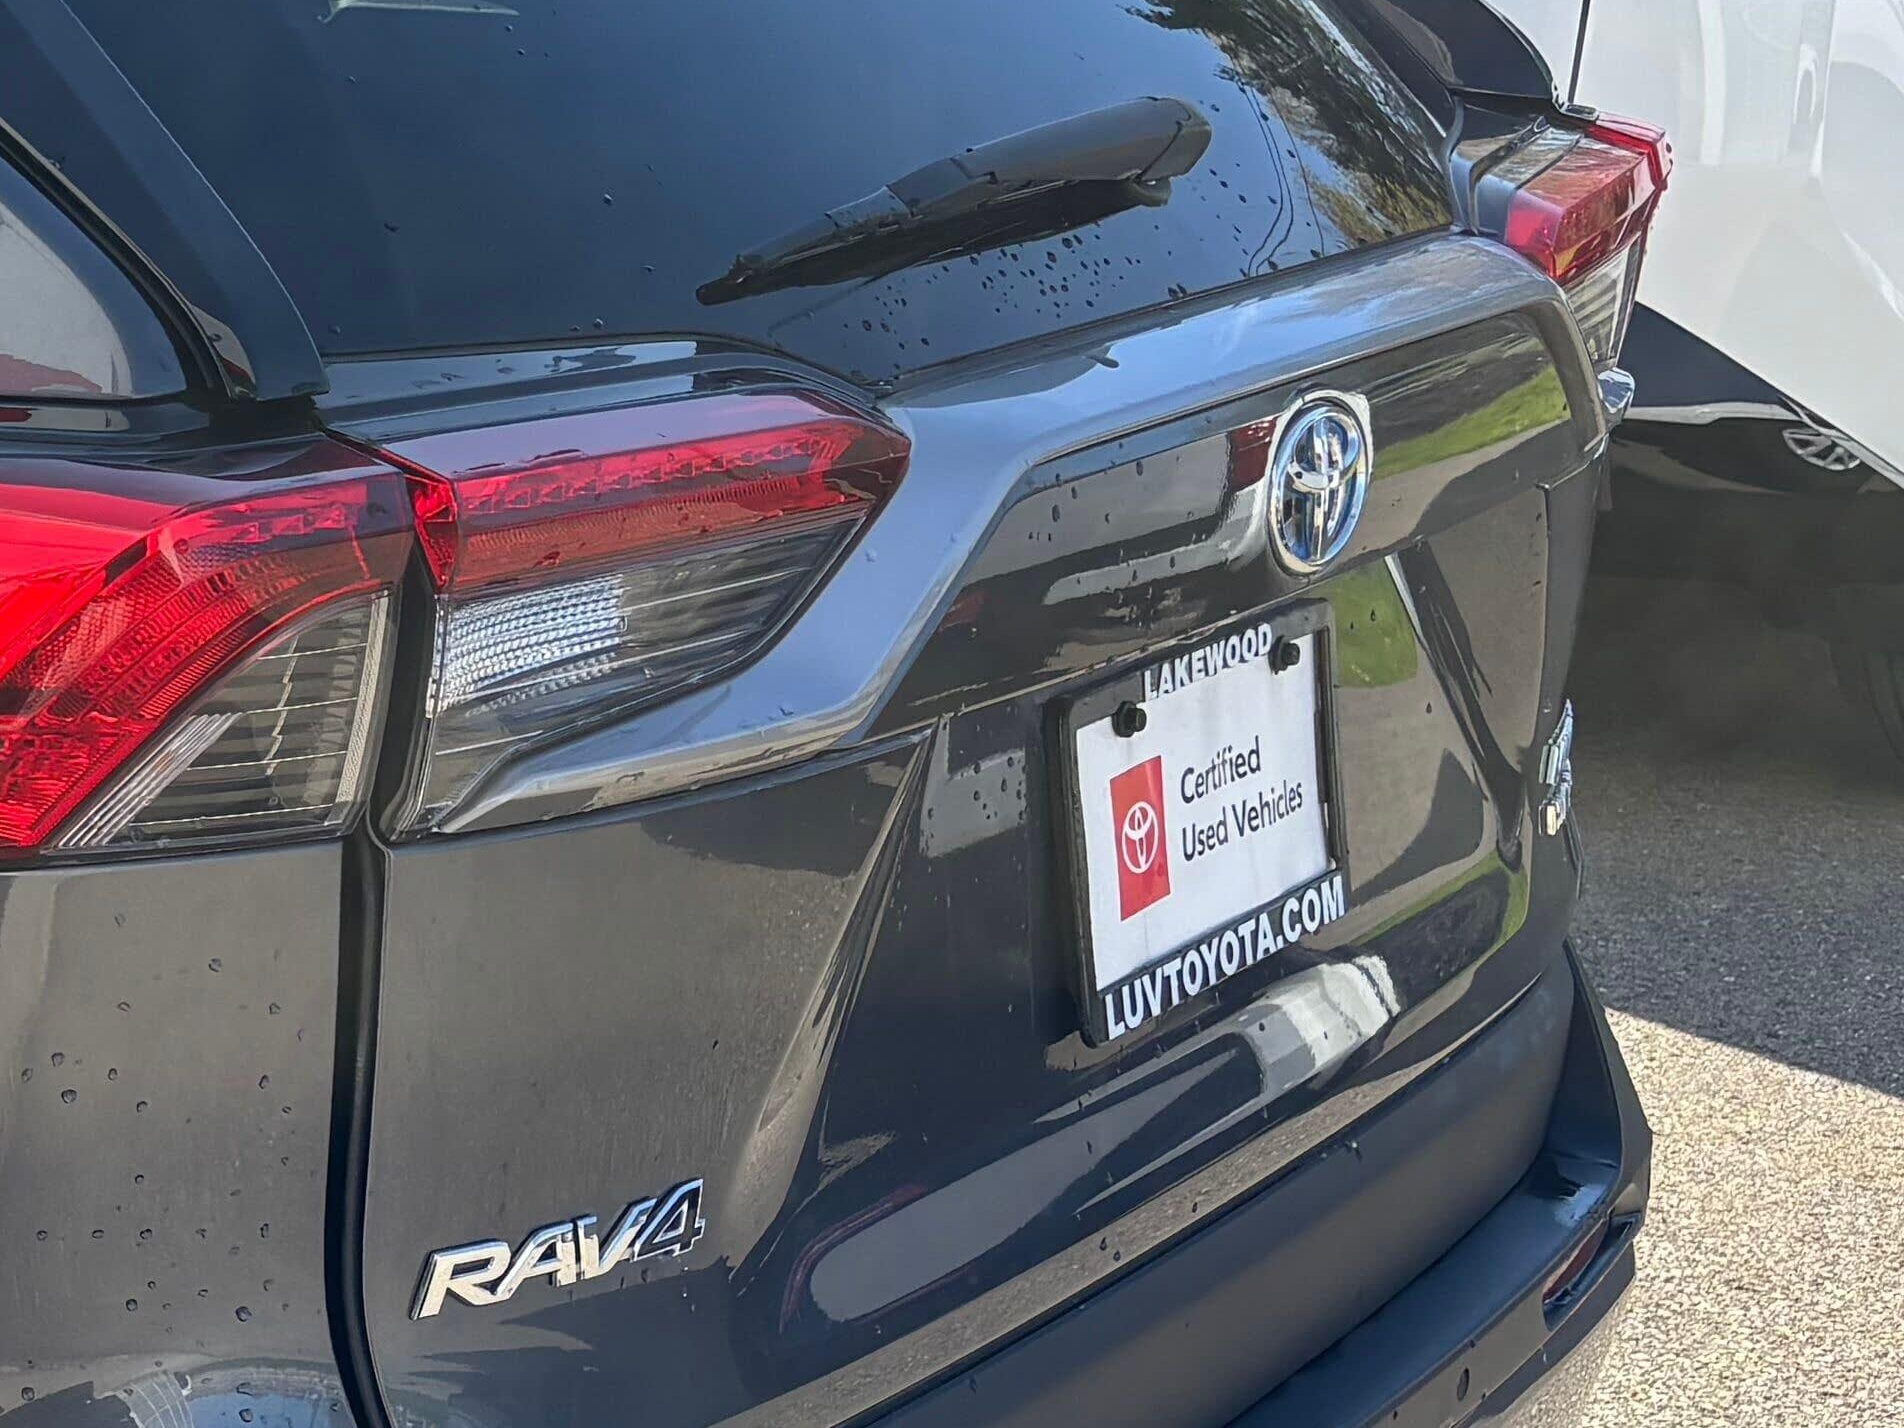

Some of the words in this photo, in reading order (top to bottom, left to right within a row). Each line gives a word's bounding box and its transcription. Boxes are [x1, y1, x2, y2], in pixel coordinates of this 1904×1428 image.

[1144, 623, 1272, 700] LAKEWOOD
[1180, 734, 1262, 804] Certified
[1182, 805, 1229, 862] Used
[1231, 779, 1303, 837] Vehicles
[1104, 874, 1346, 1041] LUVTOYOTA.COM
[408, 1177, 706, 1320] RAV4
